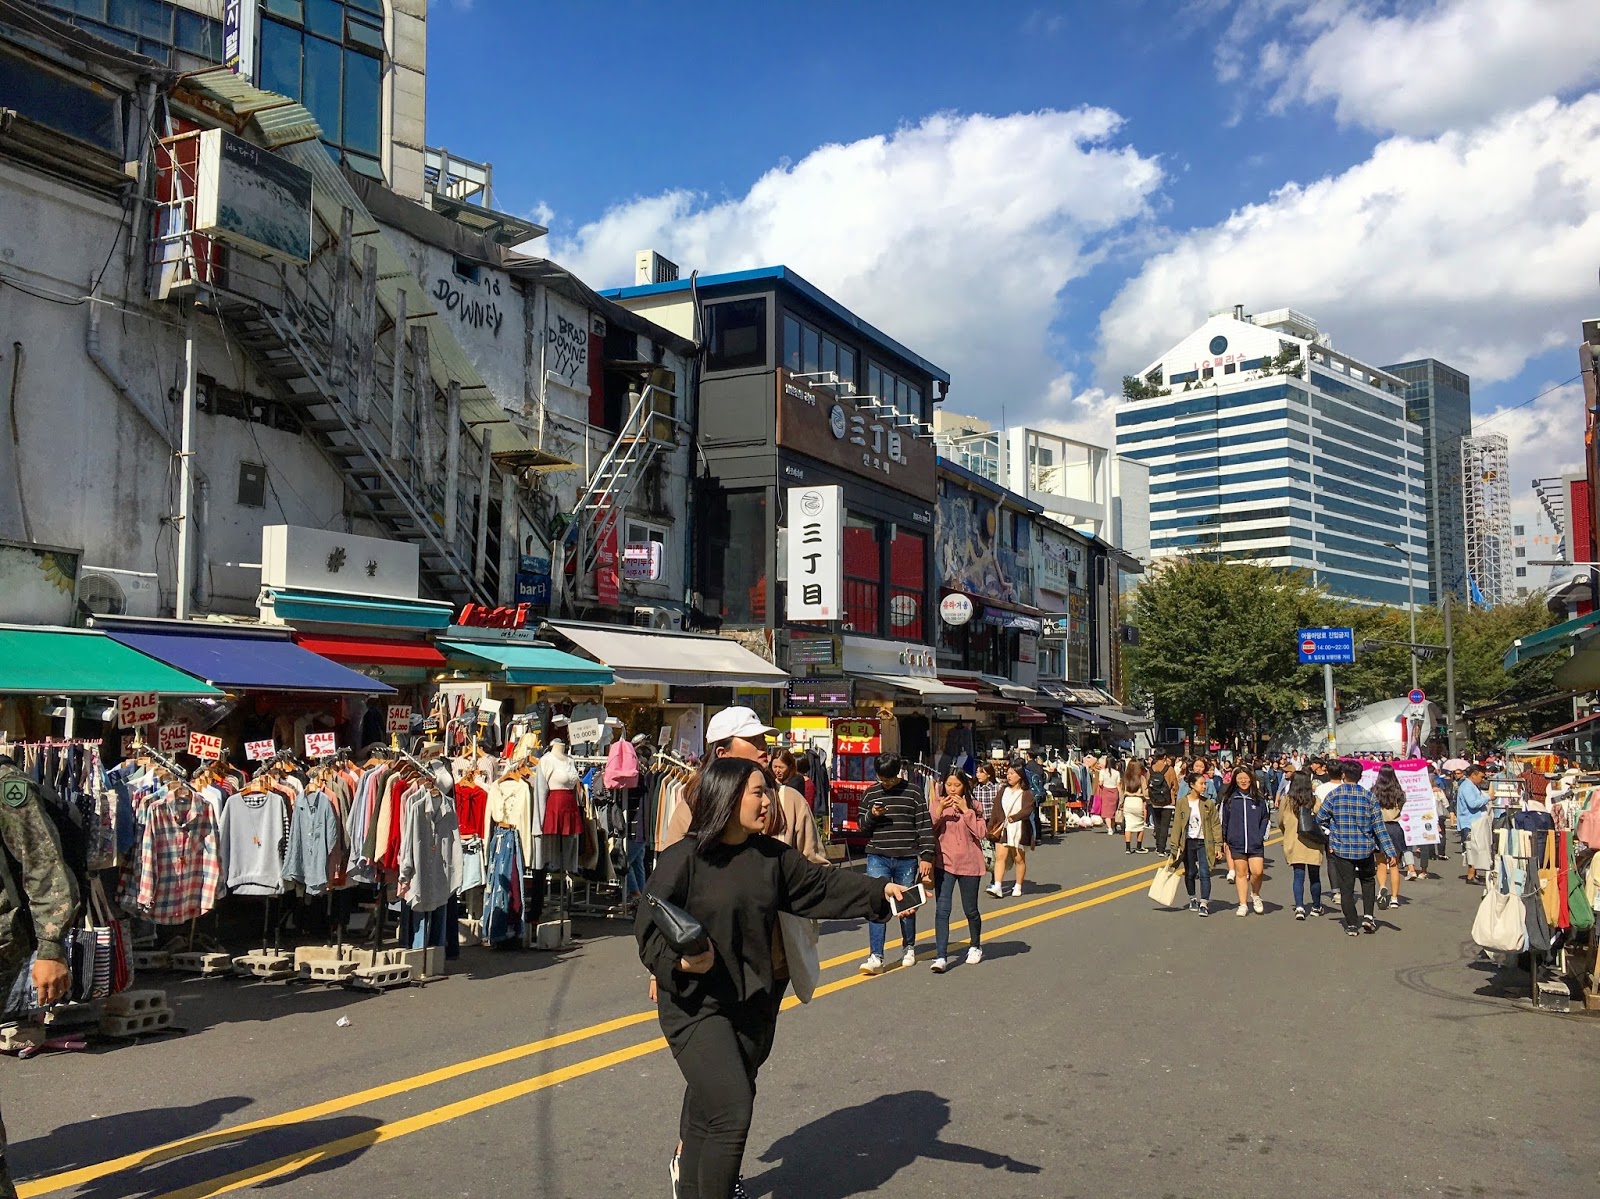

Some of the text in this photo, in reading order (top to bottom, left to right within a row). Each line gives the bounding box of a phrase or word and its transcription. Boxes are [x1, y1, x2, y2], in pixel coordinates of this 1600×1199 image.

[433, 279, 503, 337] DOWNEY
[558, 315, 586, 345] BRAD
[549, 328, 586, 364] DOWNE
[850, 415, 902, 463] 三丁目
[802, 522, 822, 605] 三丁目
[1328, 631, 1350, 639] 진입금지
[122, 693, 156, 710] SALE
[121, 711, 156, 725] 12.000
[389, 707, 410, 719] SALE
[388, 720, 408, 731] 12.000
[160, 726, 186, 741] SALE
[191, 733, 221, 748] SALE
[307, 734, 334, 743] SALE
[161, 741, 187, 751] 12.000
[190, 744, 219, 758] 12.000
[248, 740, 273, 750] SALE
[310, 744, 334, 755] 5.000
[252, 750, 274, 758] 5.000
